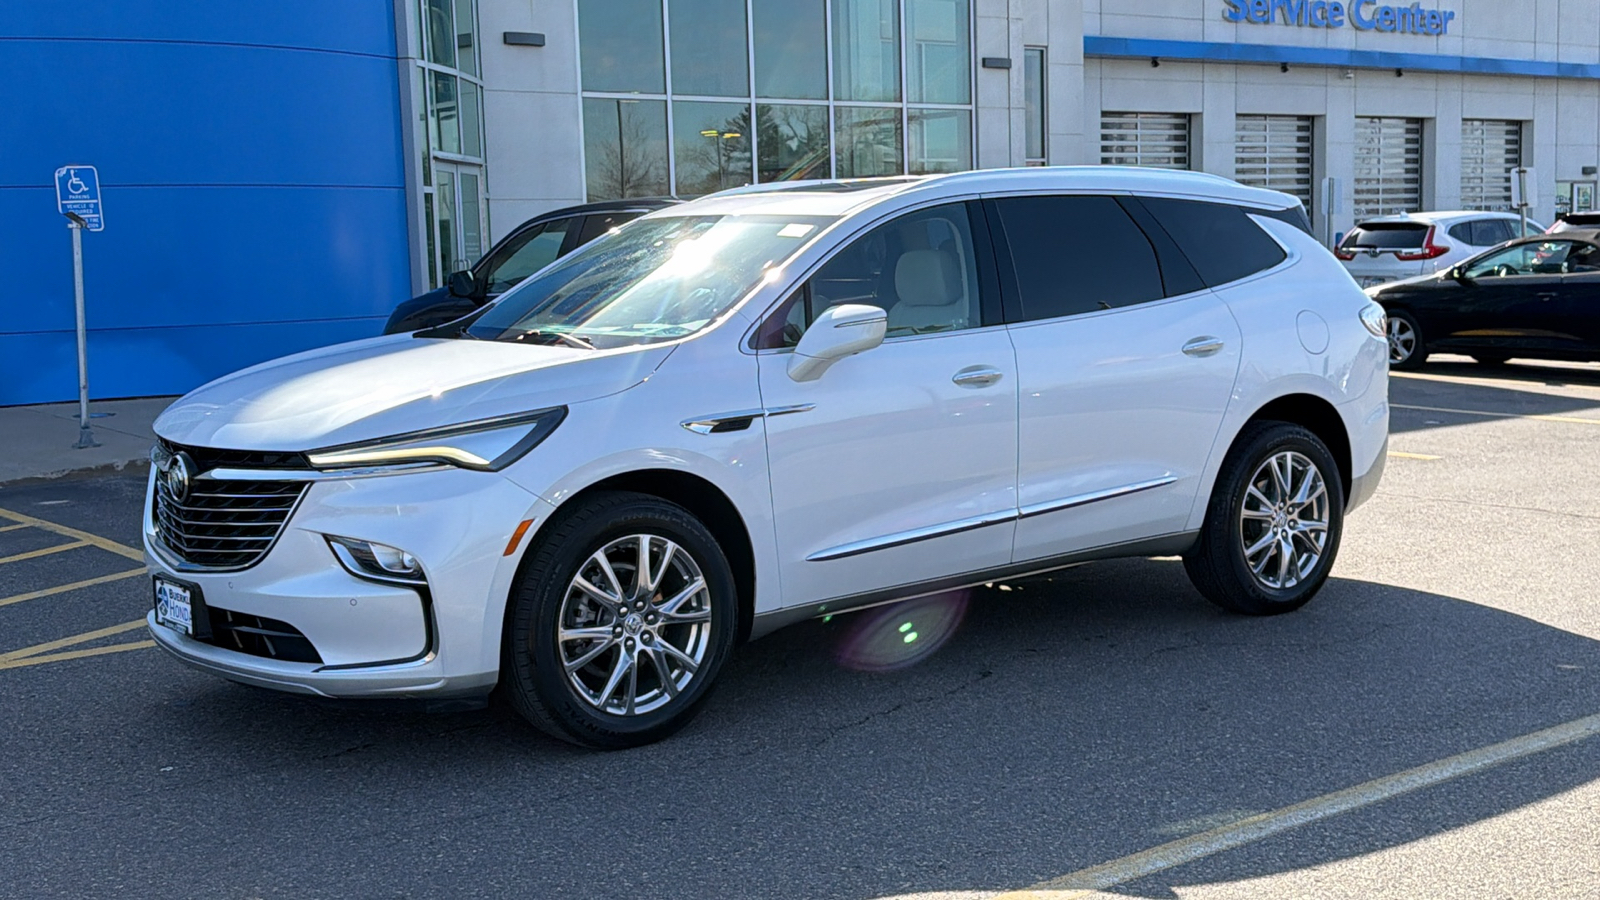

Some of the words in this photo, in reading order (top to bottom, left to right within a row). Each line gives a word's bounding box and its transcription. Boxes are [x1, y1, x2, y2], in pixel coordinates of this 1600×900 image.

[1223, 0, 1345, 27] Service
[1349, 0, 1455, 35] Center
[169, 588, 191, 605] BUERKL
[170, 599, 192, 622] HOND
